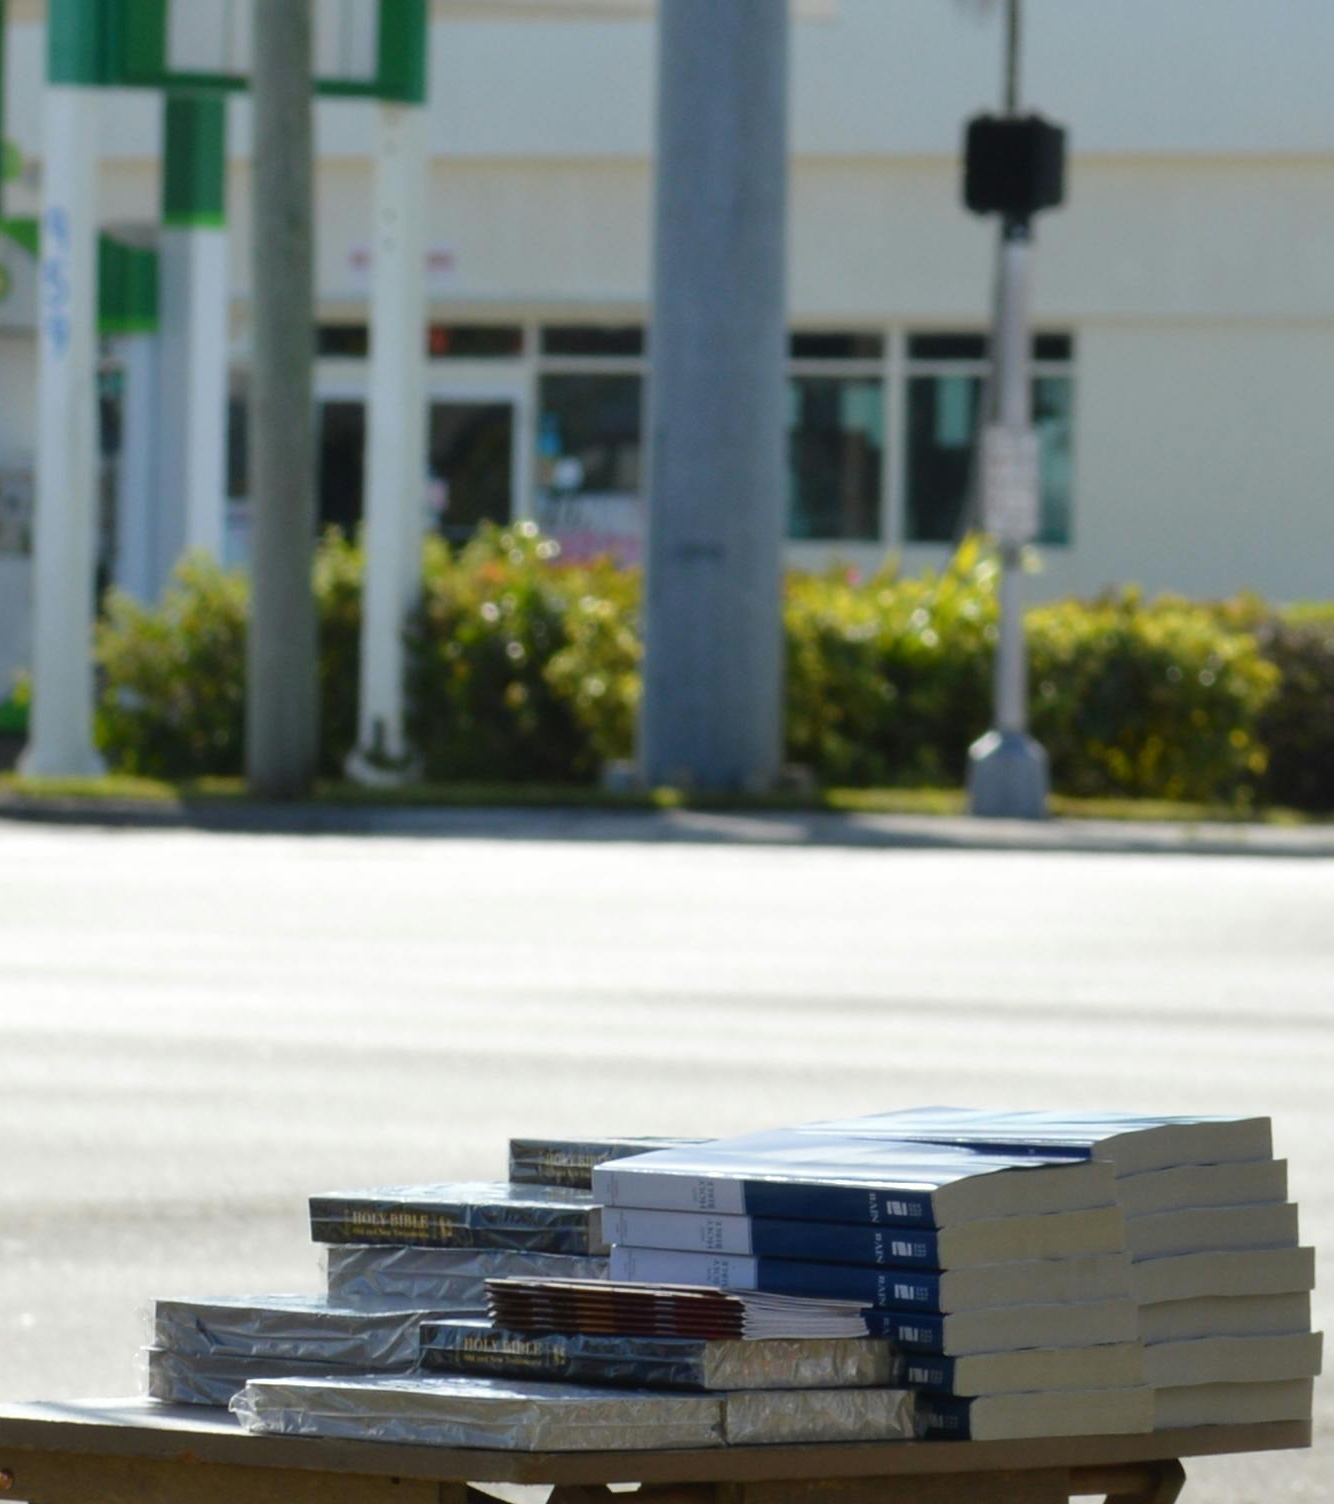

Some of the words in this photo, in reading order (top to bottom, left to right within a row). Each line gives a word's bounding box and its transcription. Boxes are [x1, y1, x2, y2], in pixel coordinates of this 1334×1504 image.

[352, 1210, 388, 1226] HOLY
[389, 1213, 429, 1230] BIBLE
[463, 1336, 498, 1352] HOLY
